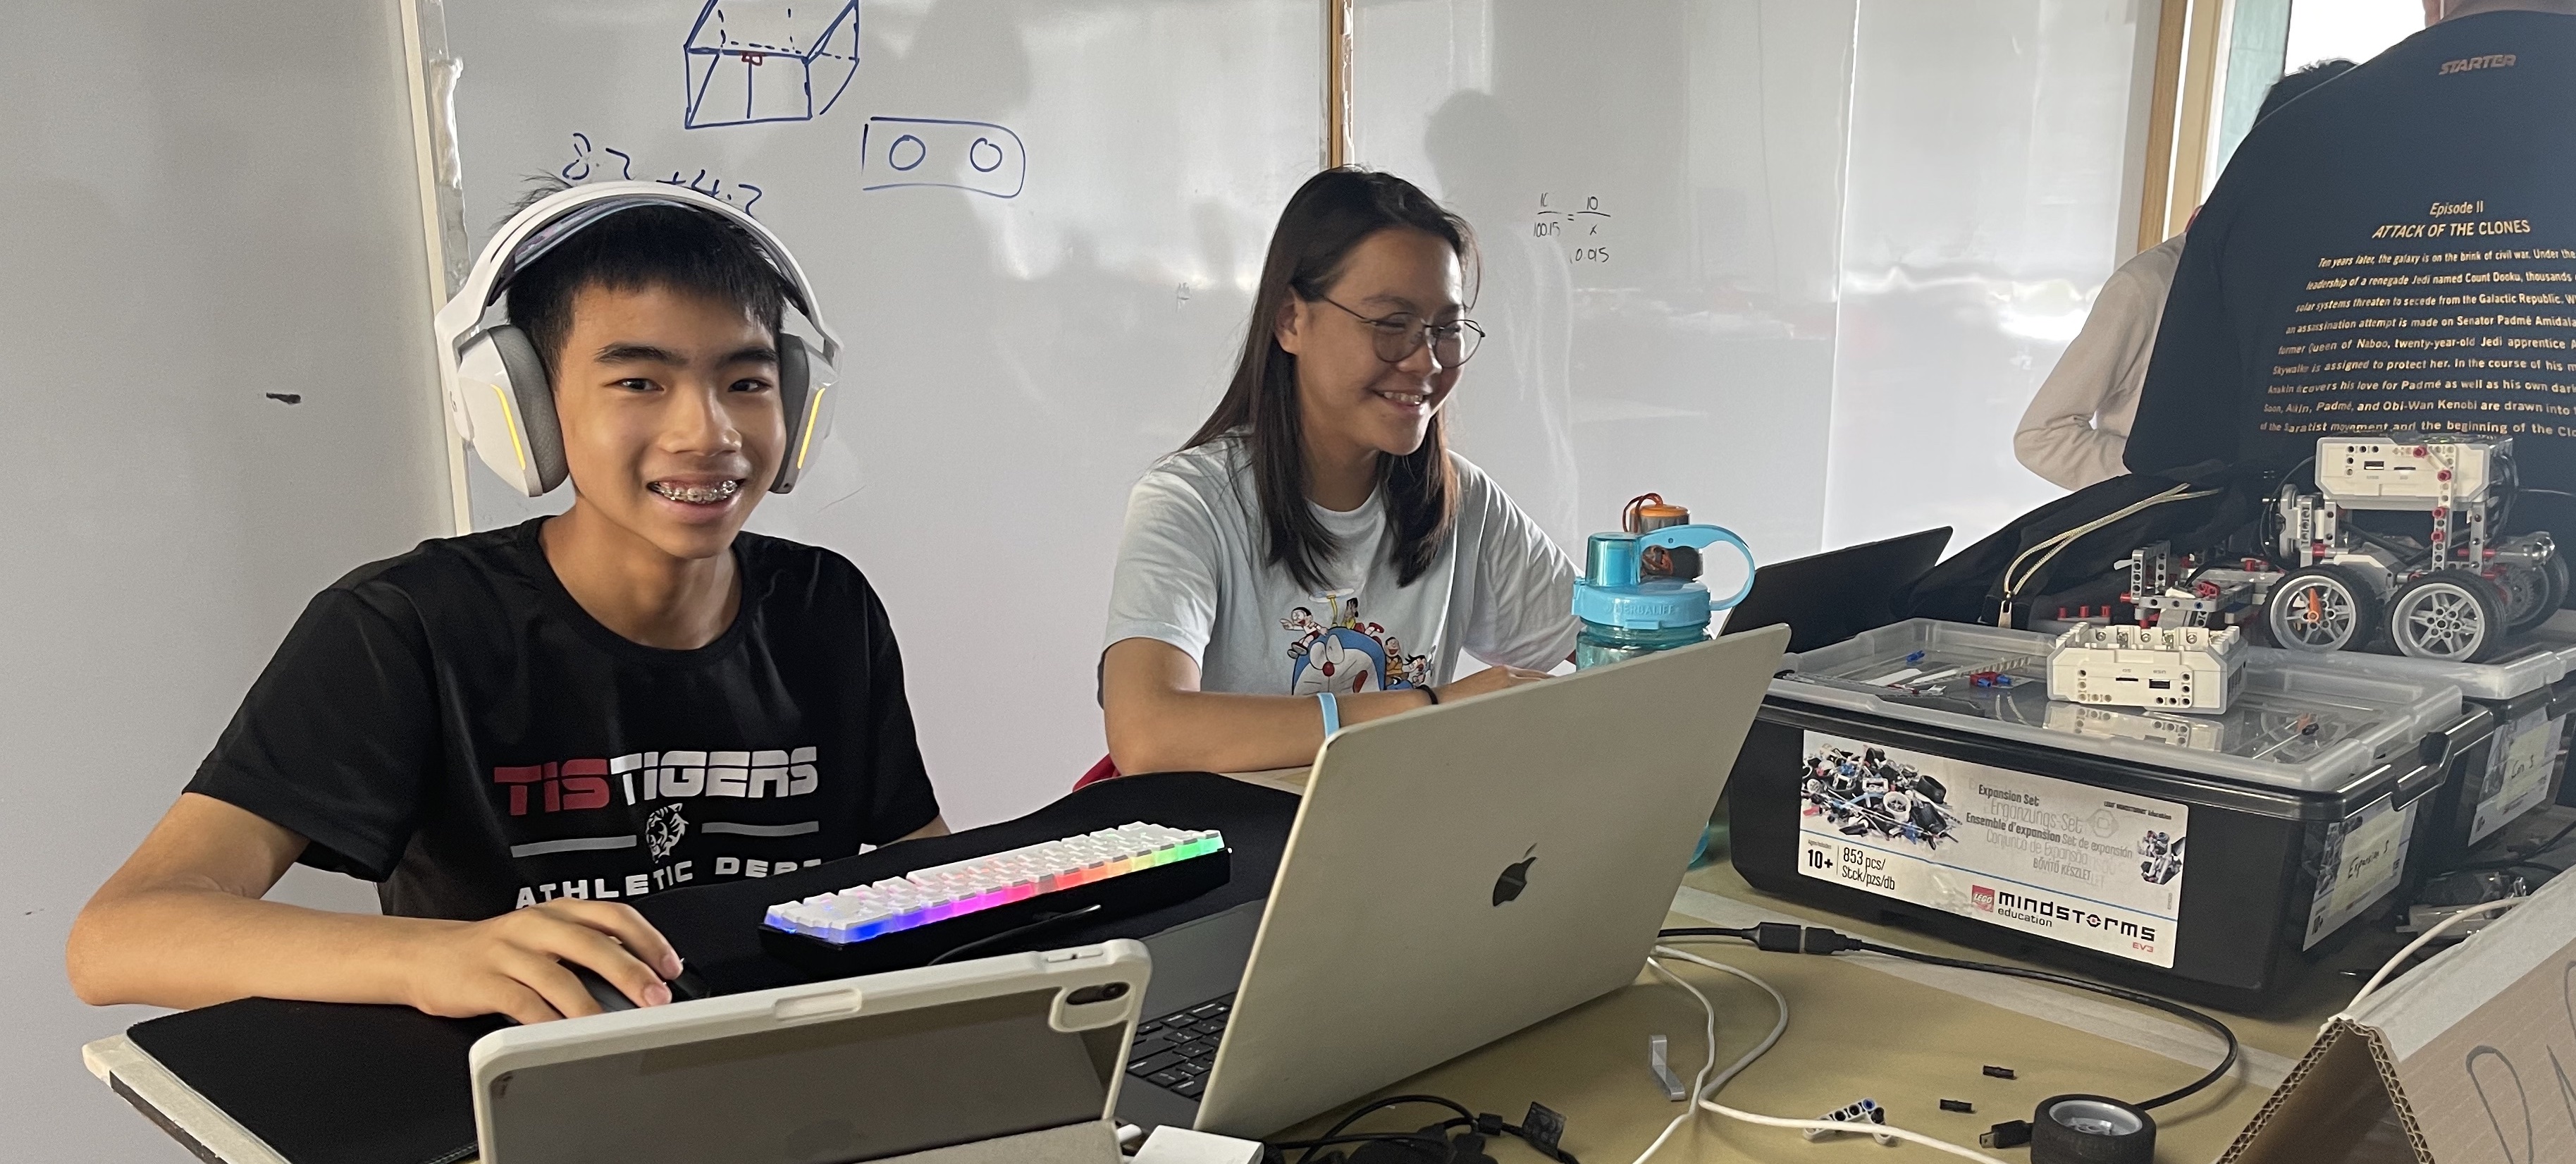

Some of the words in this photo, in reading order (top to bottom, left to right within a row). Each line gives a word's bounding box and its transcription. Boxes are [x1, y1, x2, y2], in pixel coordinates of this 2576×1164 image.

[2439, 54, 2517, 75] STARTER
[2429, 202, 2473, 219] Episode
[2372, 225, 2426, 239] ATTACK
[2427, 223, 2446, 238] OF
[2449, 223, 2475, 236] THE
[2479, 220, 2531, 235] CLONES
[2318, 257, 2331, 268] Ten
[2331, 257, 2354, 269] years
[2378, 254, 2392, 264] the
[2393, 254, 2421, 266] galaxy
[2422, 253, 2429, 263] is
[2432, 253, 2442, 262] on
[2444, 252, 2458, 262] the
[2460, 251, 2481, 262] brink
[2484, 250, 2493, 261] of
[2495, 250, 2512, 260] civil
[2533, 249, 2559, 259] Under
[2560, 249, 2576, 259] the
[2306, 277, 2348, 290] leadership
[2349, 276, 2360, 286] of
[2361, 278, 2366, 286] a
[2368, 275, 2409, 287] renegade
[2412, 274, 2431, 285] Jedi
[2432, 274, 2463, 285] named
[2465, 272, 2491, 283] Count
[2525, 271, 2572, 282] thousands
[2295, 302, 2315, 313] solar
[2316, 299, 2351, 312] systems
[2353, 297, 2391, 307] threaten
[2393, 297, 2402, 307] to
[2403, 295, 2436, 307] secede
[2439, 295, 2460, 306] from
[2463, 295, 2477, 305] the
[2479, 293, 2517, 304] Galactic
[2286, 326, 2295, 334] an
[2297, 319, 2356, 333] assassination
[2358, 318, 2396, 329] attempt
[2398, 317, 2408, 328] is
[2410, 317, 2439, 328] made
[2441, 319, 2454, 327] on
[2457, 315, 2494, 326] Senator
[2497, 314, 2532, 326] Padmé
[2278, 344, 2307, 355] former
[2341, 339, 2353, 350] of
[2356, 338, 2391, 350] Naboo,
[2394, 337, 2476, 350] twenty-year-old
[2480, 336, 2503, 348] Jedi
[2507, 338, 2566, 350] apprentice
[2311, 363, 2322, 373] is
[2324, 360, 2370, 372] assigned
[2372, 360, 2384, 369] to
[2386, 360, 2427, 371] protect
[2429, 358, 2451, 369] her.
[2454, 358, 2465, 368] In
[2468, 358, 2485, 369] the
[2488, 359, 2527, 369] course
[2530, 359, 2541, 369] of
[2545, 360, 2563, 372] his
[2340, 380, 2355, 391] his
[2357, 380, 2379, 391] love
[2381, 379, 2398, 391] for
[2401, 379, 2441, 391] Padmé
[2444, 380, 2458, 389] as
[2460, 379, 2483, 389] well
[2486, 379, 2499, 390] as
[2502, 379, 2521, 390] his
[2525, 381, 2548, 392] own
[2357, 400, 2380, 412] and
[2383, 400, 2434, 412] Obi-Wan
[2437, 399, 2477, 410] Kenobi
[2480, 400, 2501, 411] are
[2503, 400, 2543, 412] drawn
[2546, 403, 2570, 416] into
[2269, 422, 2281, 431] the
[2392, 422, 2417, 431] and
[2421, 420, 2441, 430] the
[2447, 420, 2508, 434] beginning
[2513, 422, 2526, 433] of
[2532, 423, 2553, 435] the
[1978, 784, 2022, 803] Expansion
[2023, 794, 2040, 807] Set
[1966, 811, 2007, 831] Ensemble
[2062, 833, 2078, 846] Set
[2078, 837, 2090, 850] de
[1808, 849, 1833, 869] 10+
[1843, 847, 1863, 865] 853
[516, 860, 694, 909] ATHLETIC
[1973, 893, 1993, 905] LEGO
[1997, 907, 2052, 928] education
[2132, 941, 2154, 953] EV3
